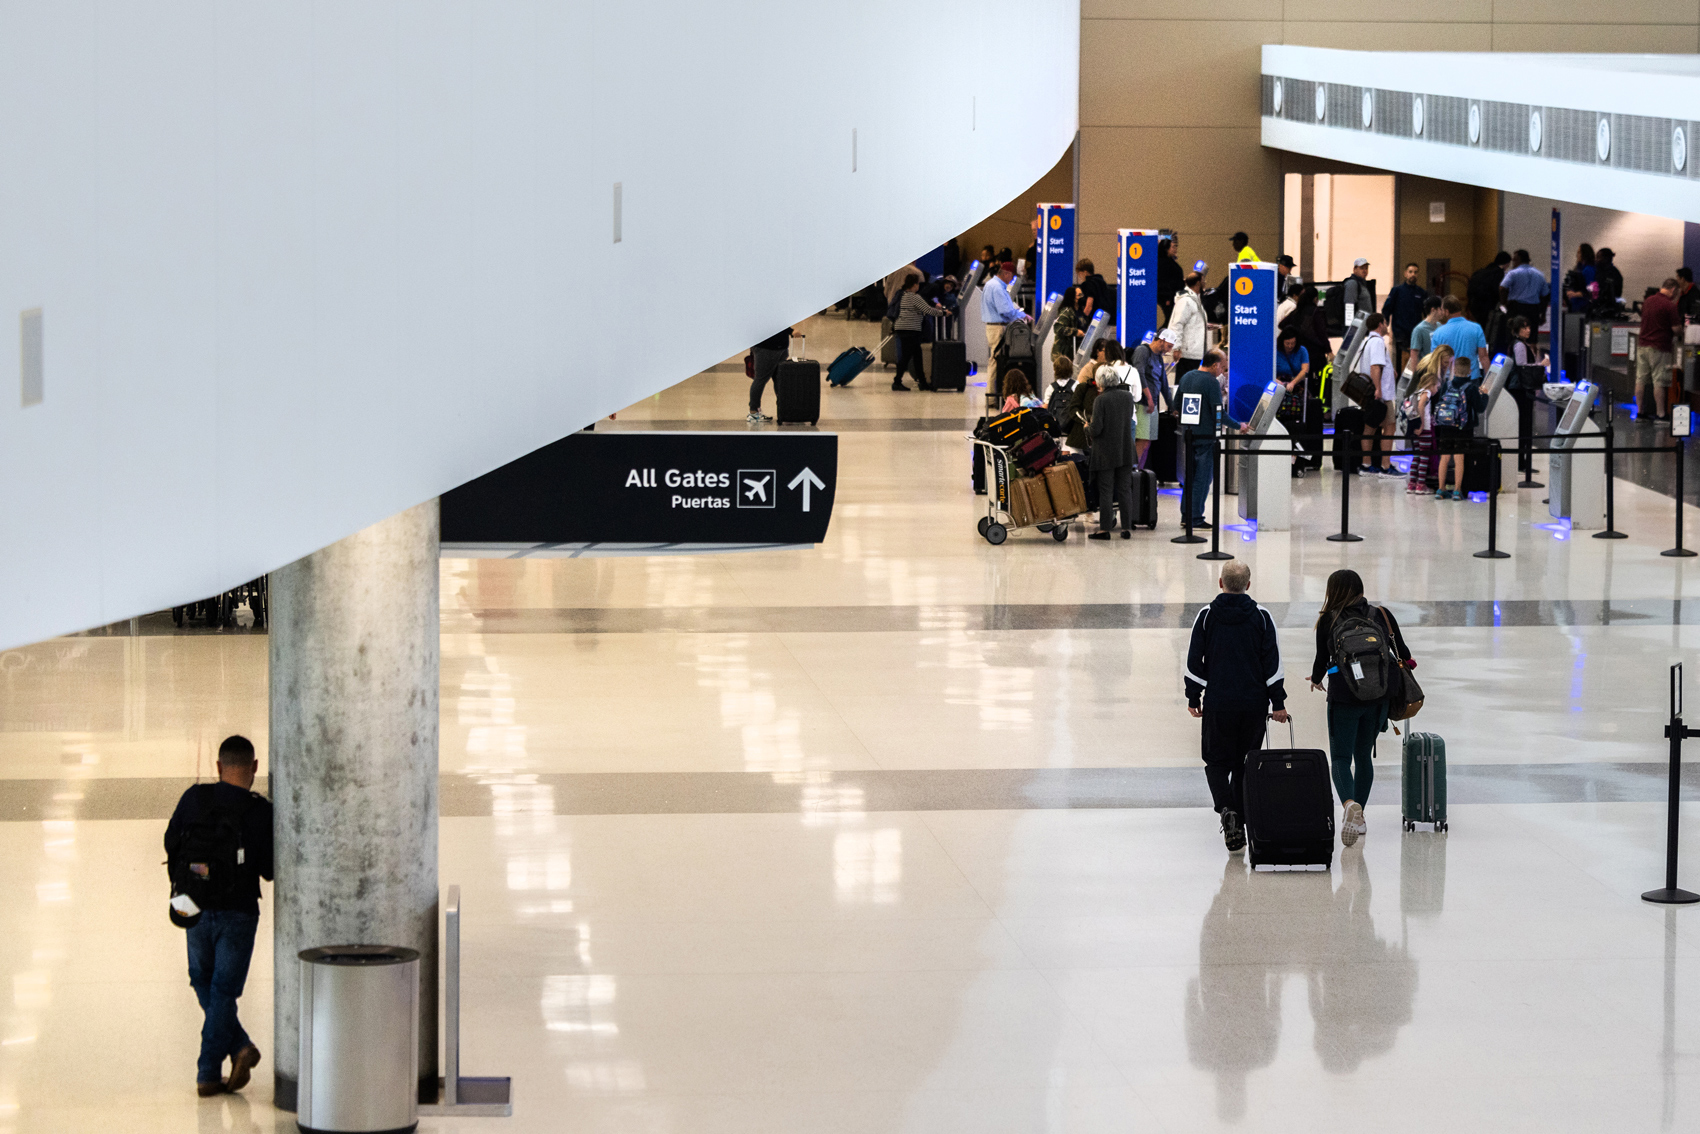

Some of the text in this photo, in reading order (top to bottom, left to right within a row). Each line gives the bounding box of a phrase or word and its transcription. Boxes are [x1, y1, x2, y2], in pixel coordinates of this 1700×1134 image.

[1129, 268, 1146, 276] Start
[1129, 278, 1146, 286] Here
[1234, 304, 1258, 314] Start
[1234, 316, 1258, 326] Here
[625, 468, 730, 488] All Gates
[672, 496, 730, 508] Puertas
